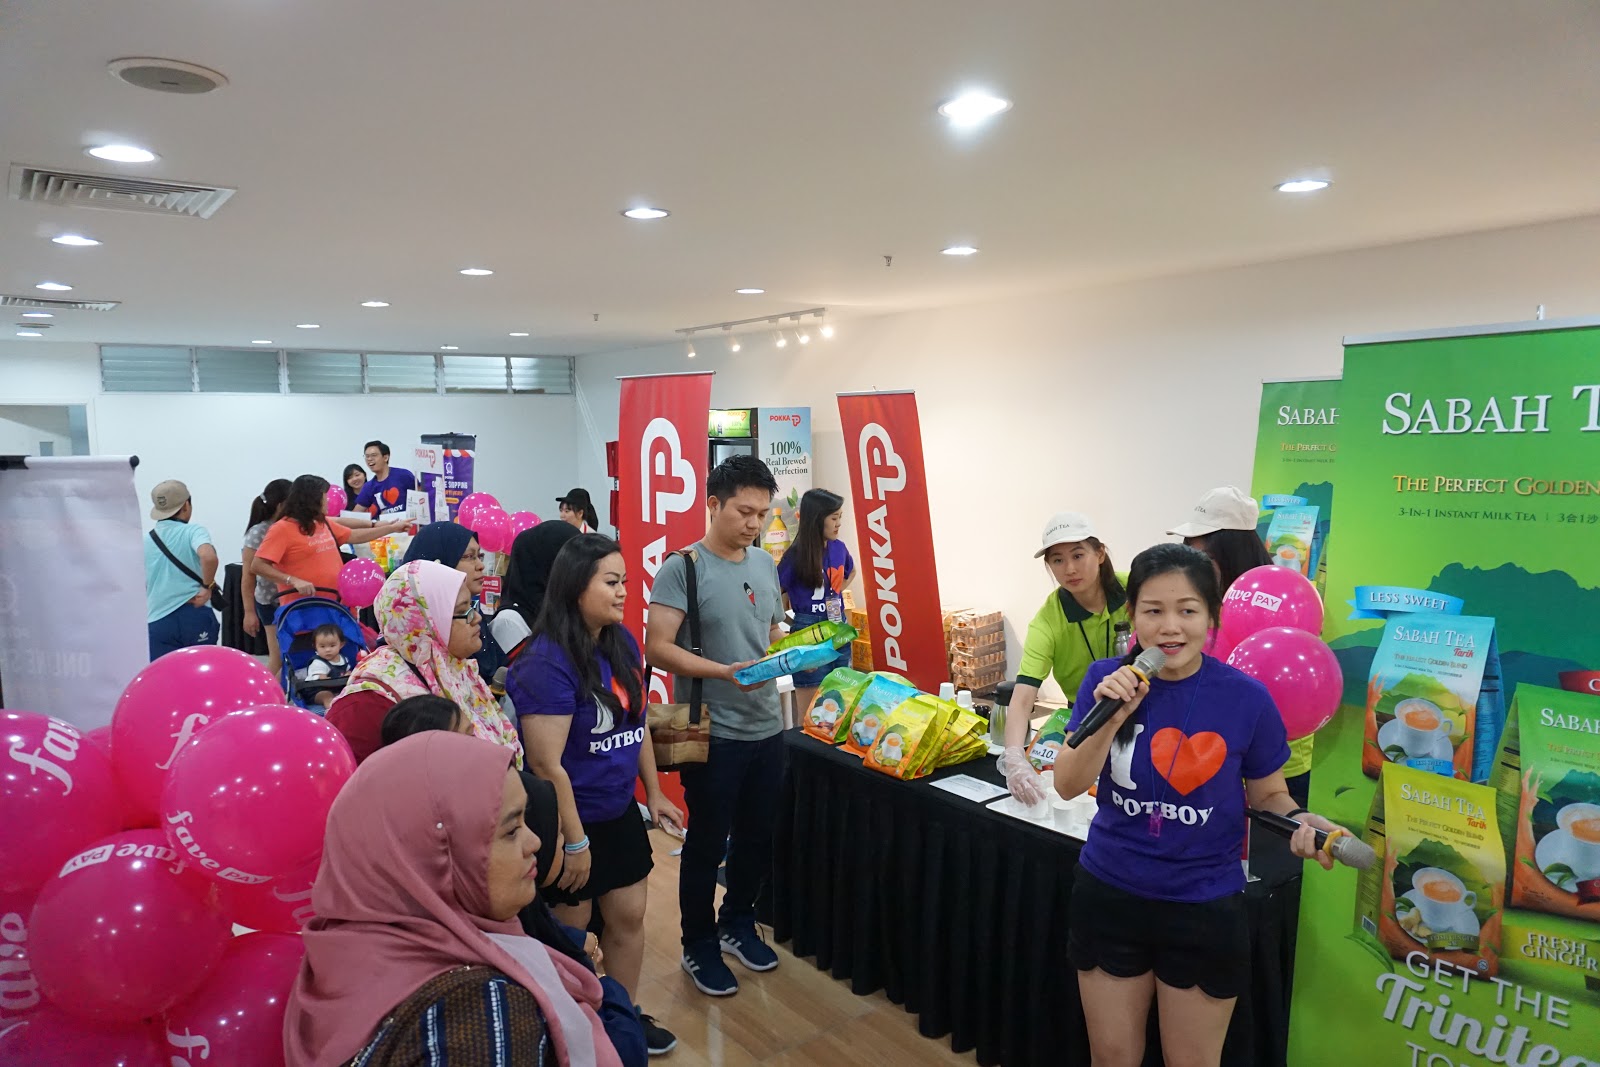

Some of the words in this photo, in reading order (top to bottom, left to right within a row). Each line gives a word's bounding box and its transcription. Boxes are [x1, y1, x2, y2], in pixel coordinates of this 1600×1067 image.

[1382, 392, 1552, 435] SABAH
[770, 440, 801, 455] 100%
[766, 457, 781, 466] Real
[782, 456, 807, 465] Brewed
[773, 466, 808, 475] Perfection
[1393, 475, 1428, 492] THE
[1433, 475, 1508, 493] PERFECT
[1514, 477, 1600, 496] GOLDEN
[1398, 507, 1431, 517] 3-IN-1
[1435, 509, 1478, 519] INSTANT
[1482, 511, 1512, 520] MILK
[1515, 512, 1537, 521] TEA
[867, 504, 908, 672] POKKA
[1254, 593, 1279, 608] PAY
[1370, 591, 1400, 604] LESS
[1404, 593, 1448, 611] SWEET
[1393, 625, 1440, 645] SABAH
[1445, 630, 1475, 648] TEA
[1454, 647, 1474, 658] Tarik
[1111, 790, 1214, 827] POTBOY
[1401, 784, 1451, 811] SABAH
[1456, 797, 1486, 820] TEA
[1467, 817, 1487, 829] Tarik
[166, 809, 221, 870] fave
[1527, 932, 1586, 956] FRESH
[1521, 944, 1598, 971] GINGER
[1406, 950, 1479, 993] GET
[1490, 976, 1570, 1028] THE
